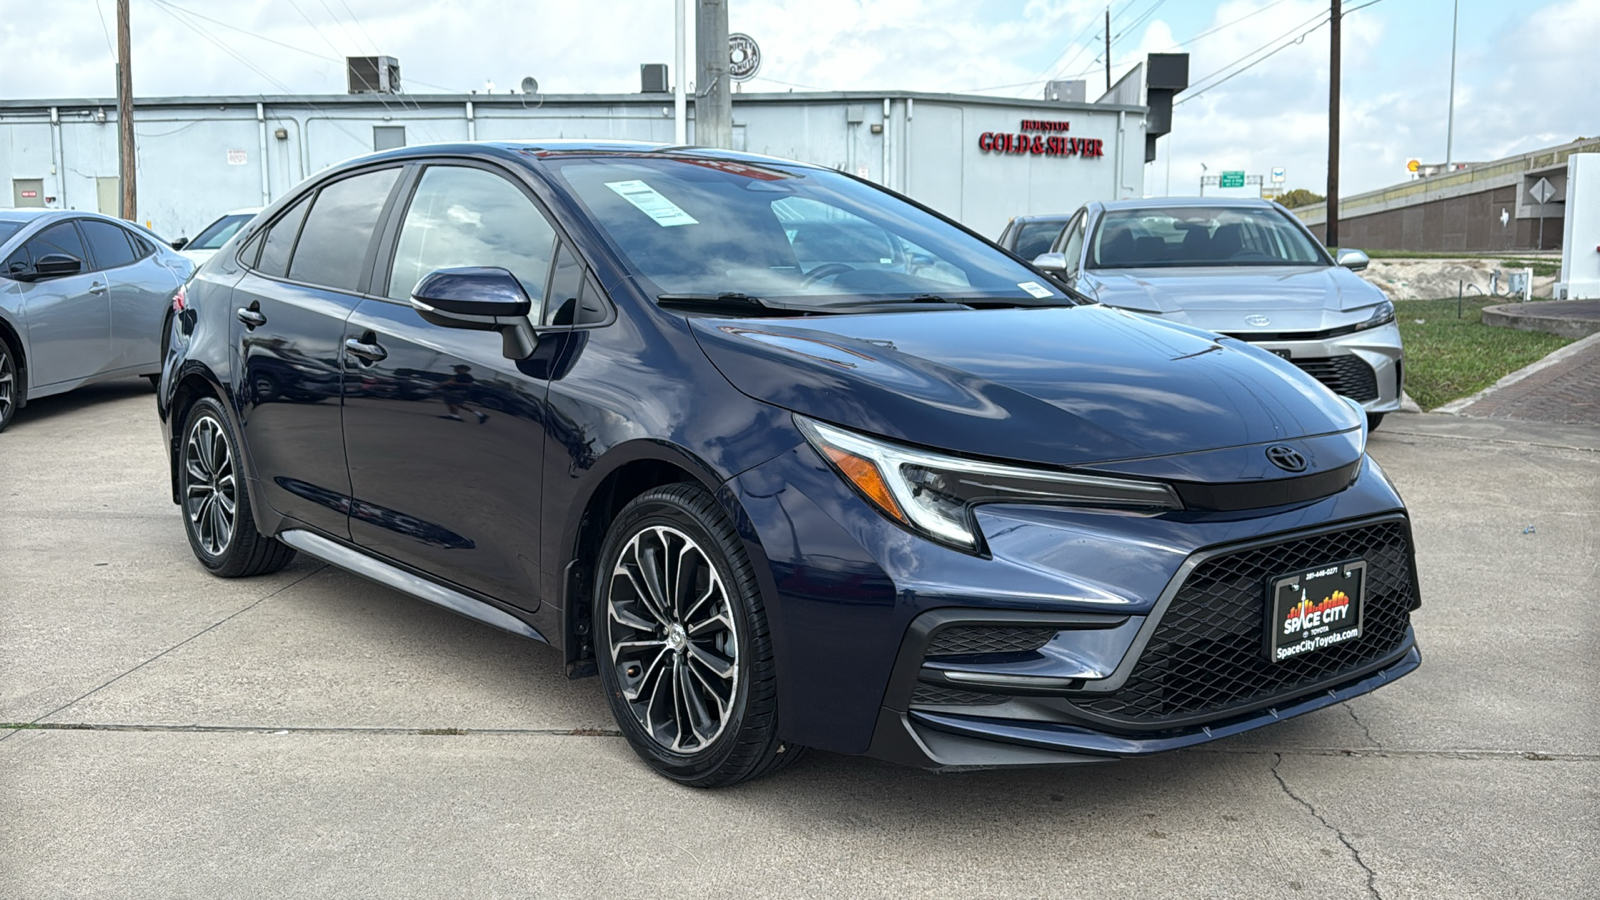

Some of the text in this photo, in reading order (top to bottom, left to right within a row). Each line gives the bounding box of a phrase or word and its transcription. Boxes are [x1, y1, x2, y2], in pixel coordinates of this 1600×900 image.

[1021, 120, 1070, 131] HOUSTON
[1284, 604, 1349, 634] SPACE CITY
[1310, 626, 1329, 635] TOYOTA
[1277, 628, 1358, 659] SpaceCityToyota.com
